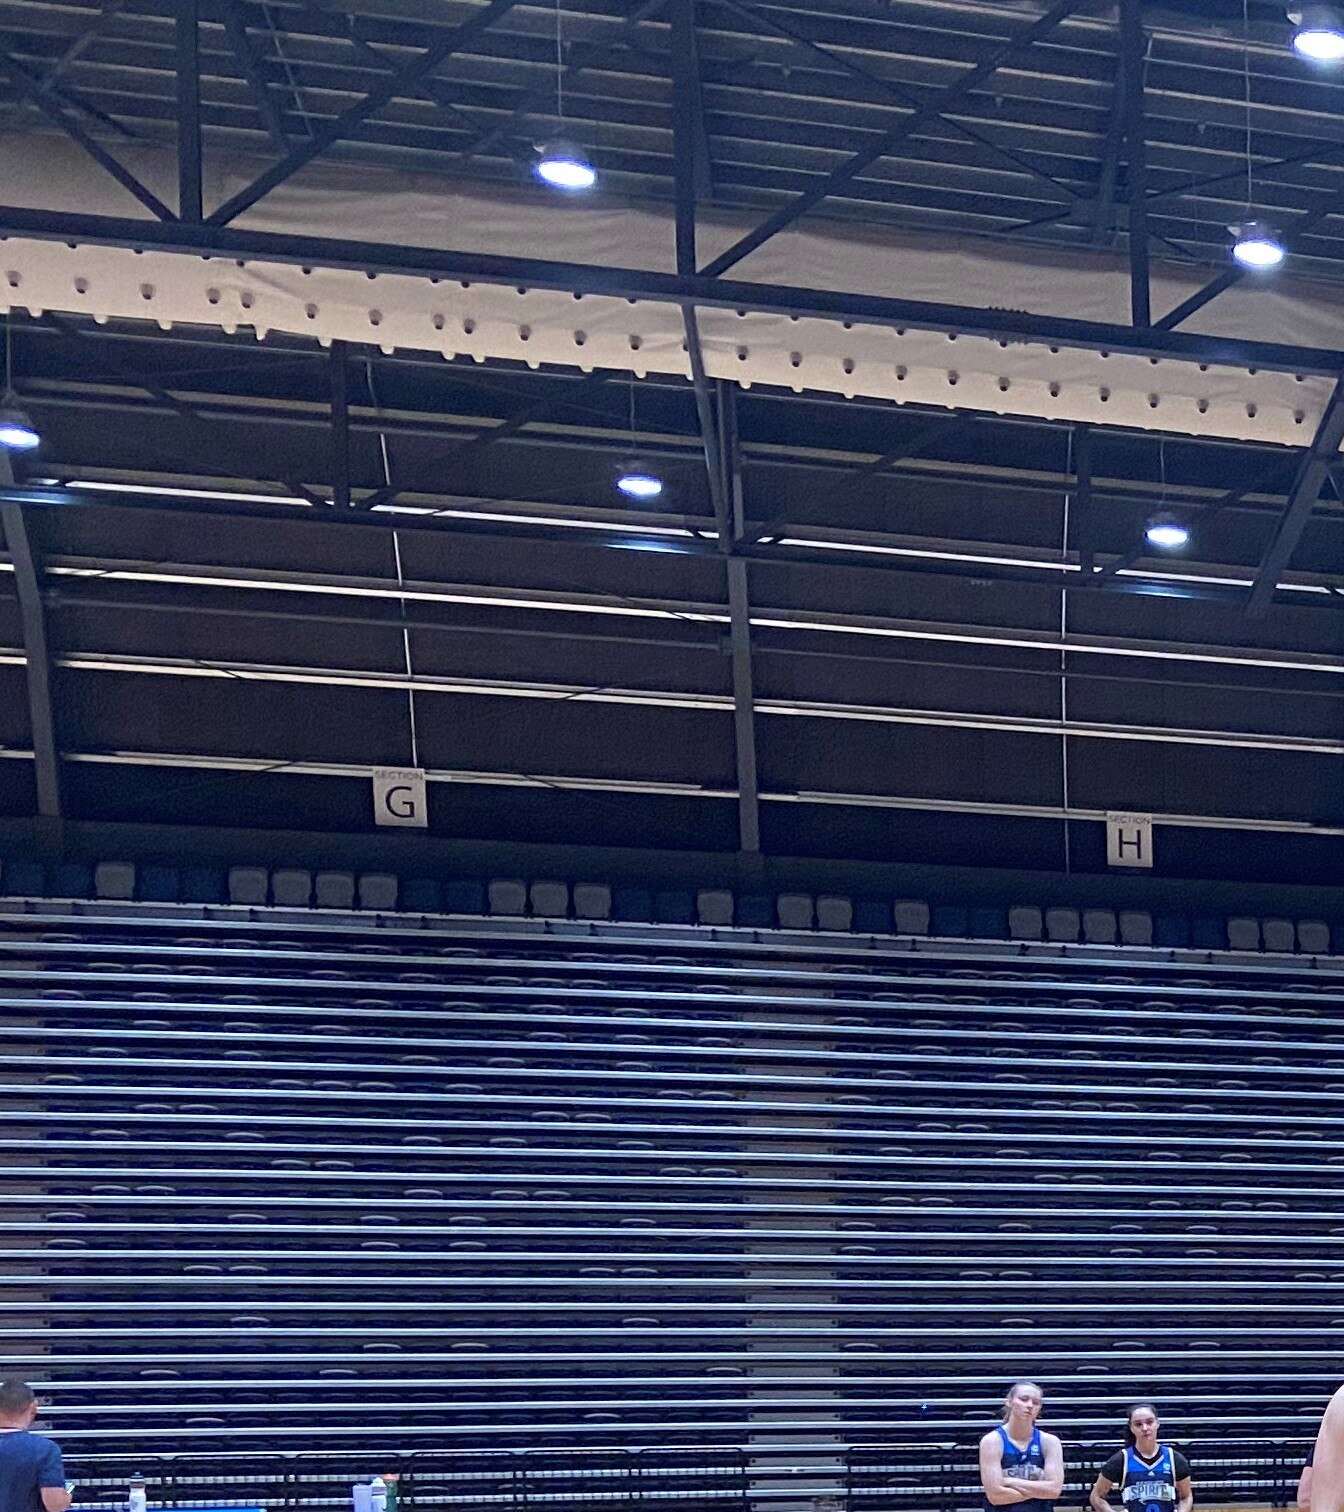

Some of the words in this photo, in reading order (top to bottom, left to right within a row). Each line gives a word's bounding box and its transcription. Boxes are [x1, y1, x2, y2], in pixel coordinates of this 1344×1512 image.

[374, 770, 424, 781] SECTION
[385, 785, 416, 819] G
[1118, 828, 1142, 860] H
